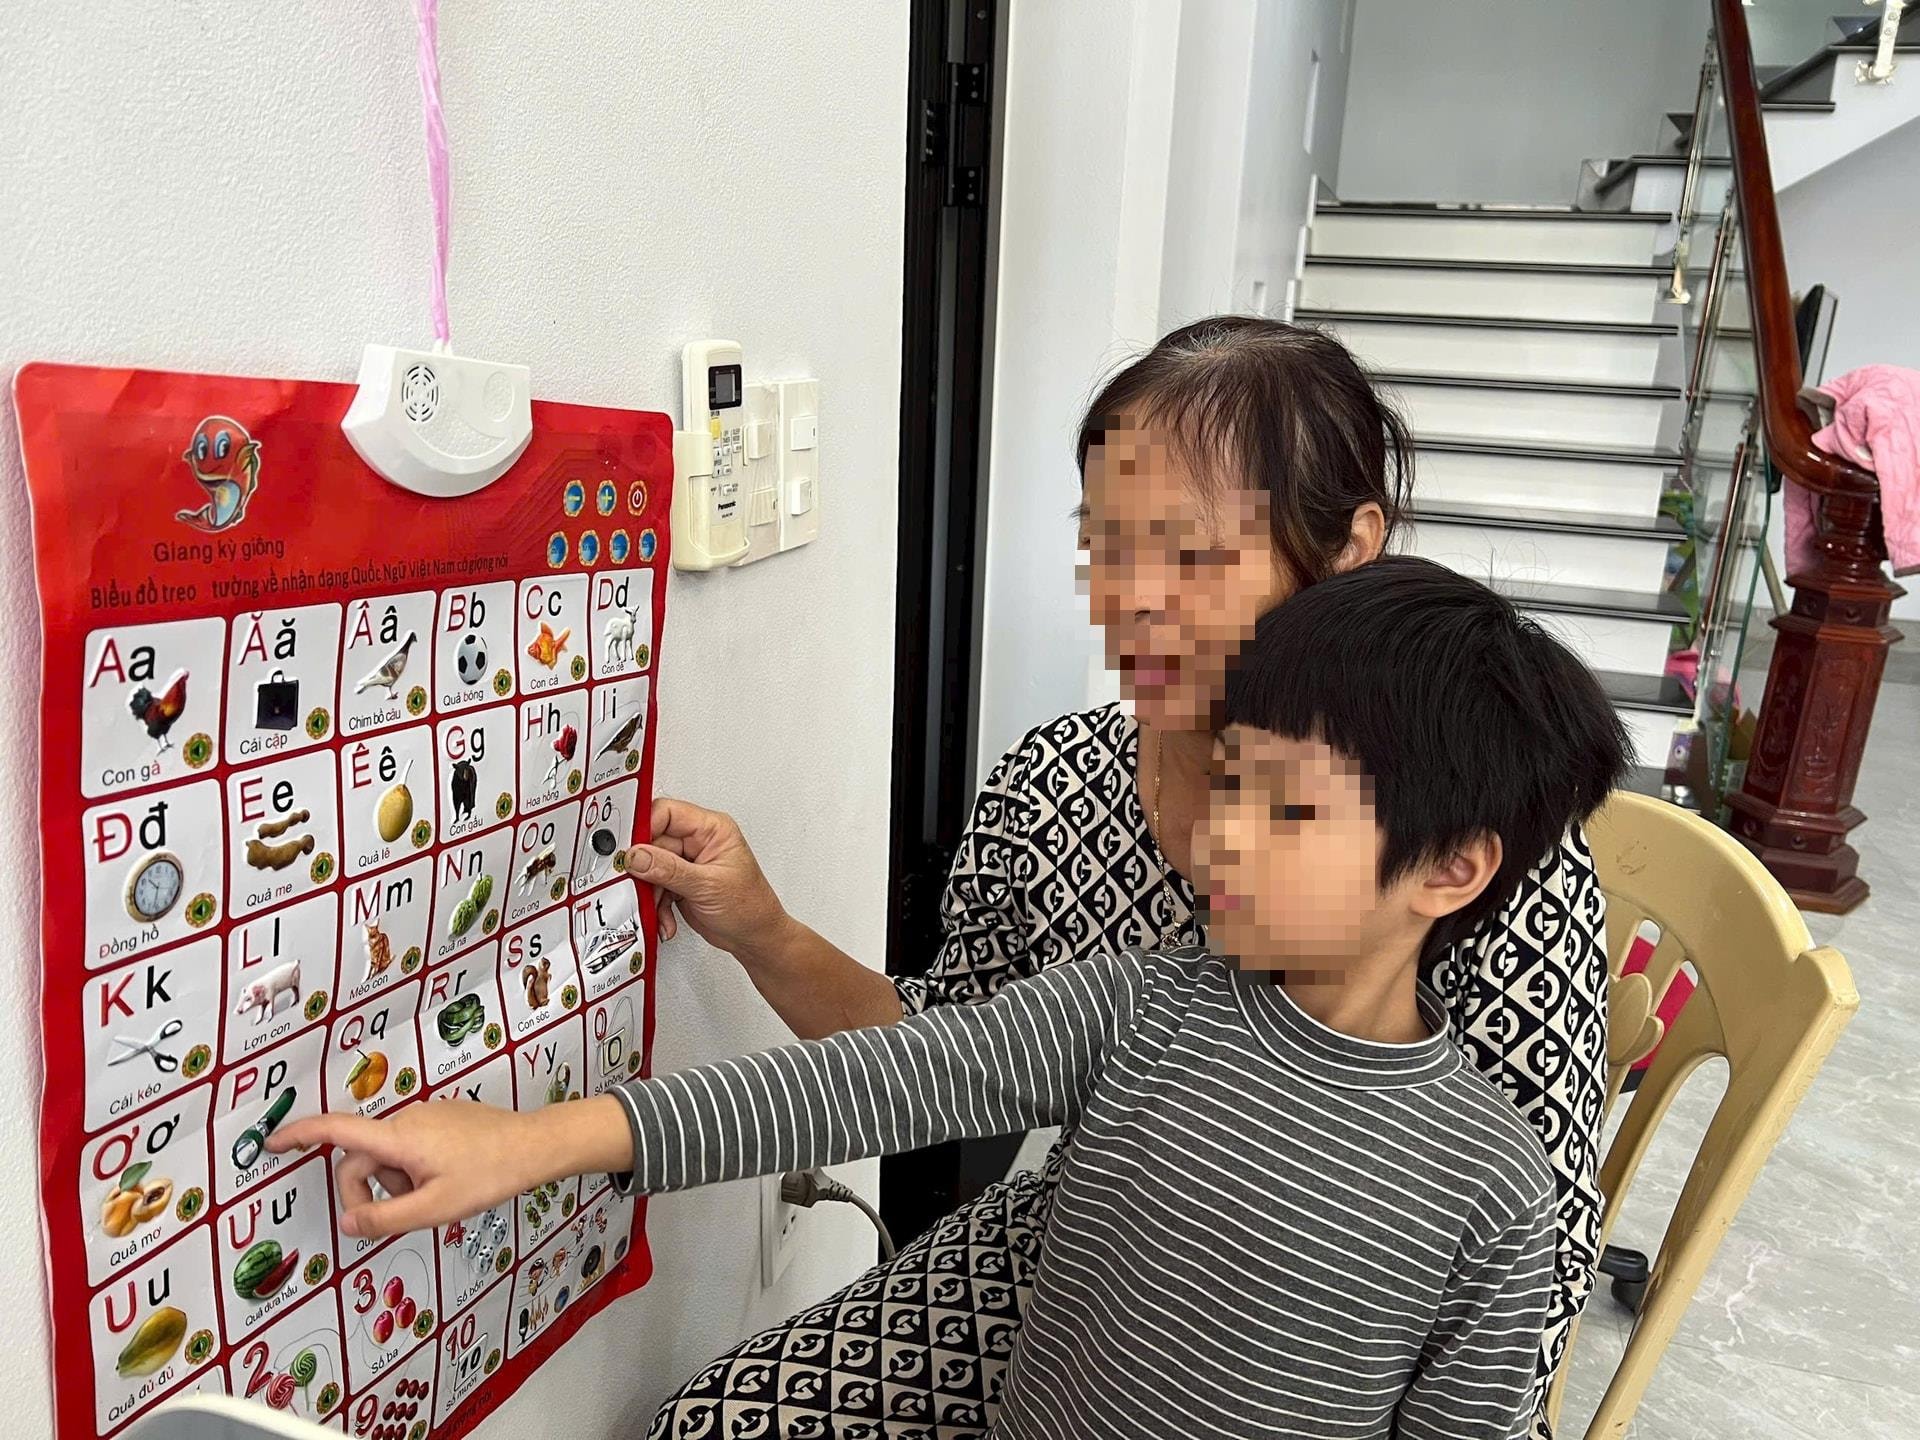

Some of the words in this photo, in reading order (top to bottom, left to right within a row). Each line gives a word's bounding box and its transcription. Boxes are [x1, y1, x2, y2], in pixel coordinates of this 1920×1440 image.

[154, 542, 213, 564] Giang
[92, 578, 130, 609] Biểu
[136, 576, 158, 605] đồ
[162, 584, 197, 602] treo
[212, 575, 259, 598] tường
[263, 565, 278, 592] về
[282, 567, 315, 593] nhận
[318, 569, 349, 589] dạng
[352, 559, 382, 584] Quốc
[384, 560, 406, 583] Ngữ
[409, 559, 430, 578] Việt
[434, 560, 454, 575] Nam
[597, 576, 629, 610] Dd
[446, 592, 486, 632] Bb
[90, 638, 156, 688] Aa
[602, 664, 616, 675] Con
[530, 678, 546, 690] Con
[443, 692, 461, 706] Quả
[464, 690, 484, 702] bóng
[348, 714, 373, 730] Chim
[374, 708, 384, 724] bồ
[525, 702, 560, 740] Hh
[240, 737, 262, 755] Cái
[446, 725, 485, 762] Gg
[102, 767, 136, 787] Con
[142, 761, 160, 782] gà
[594, 772, 606, 783] Con
[606, 767, 620, 778] chim
[526, 797, 541, 809] Hoa
[542, 790, 559, 803] hồng
[450, 824, 466, 836] Con
[358, 851, 379, 868] Quả
[246, 887, 272, 906] Quả
[276, 883, 292, 898] me
[353, 878, 412, 926] Mm
[511, 906, 526, 920] Con
[527, 901, 540, 914] ong
[99, 936, 136, 958] Đồng
[142, 924, 160, 944] hồ
[456, 936, 467, 948] na
[350, 982, 370, 1000] Mèo
[372, 974, 388, 989] con
[244, 1034, 267, 1051] Lợn
[270, 1022, 291, 1038] con
[518, 1018, 534, 1033] Con
[437, 1060, 456, 1076] Con
[230, 1060, 288, 1110] Pp
[109, 1093, 132, 1116] Cái
[137, 1082, 162, 1104] kéo
[366, 1096, 386, 1114] cam
[234, 1167, 259, 1189] Đèn
[262, 1156, 280, 1175] pin
[110, 1240, 137, 1267] Quả
[140, 1226, 162, 1248] mơ
[353, 1268, 376, 1314] 3
[446, 1313, 476, 1366] 10
[386, 1348, 398, 1362] ba
[460, 1346, 481, 1379] 10
[243, 1341, 273, 1399] 2
[108, 1394, 136, 1422] Quả
[355, 1394, 380, 1438] 9
